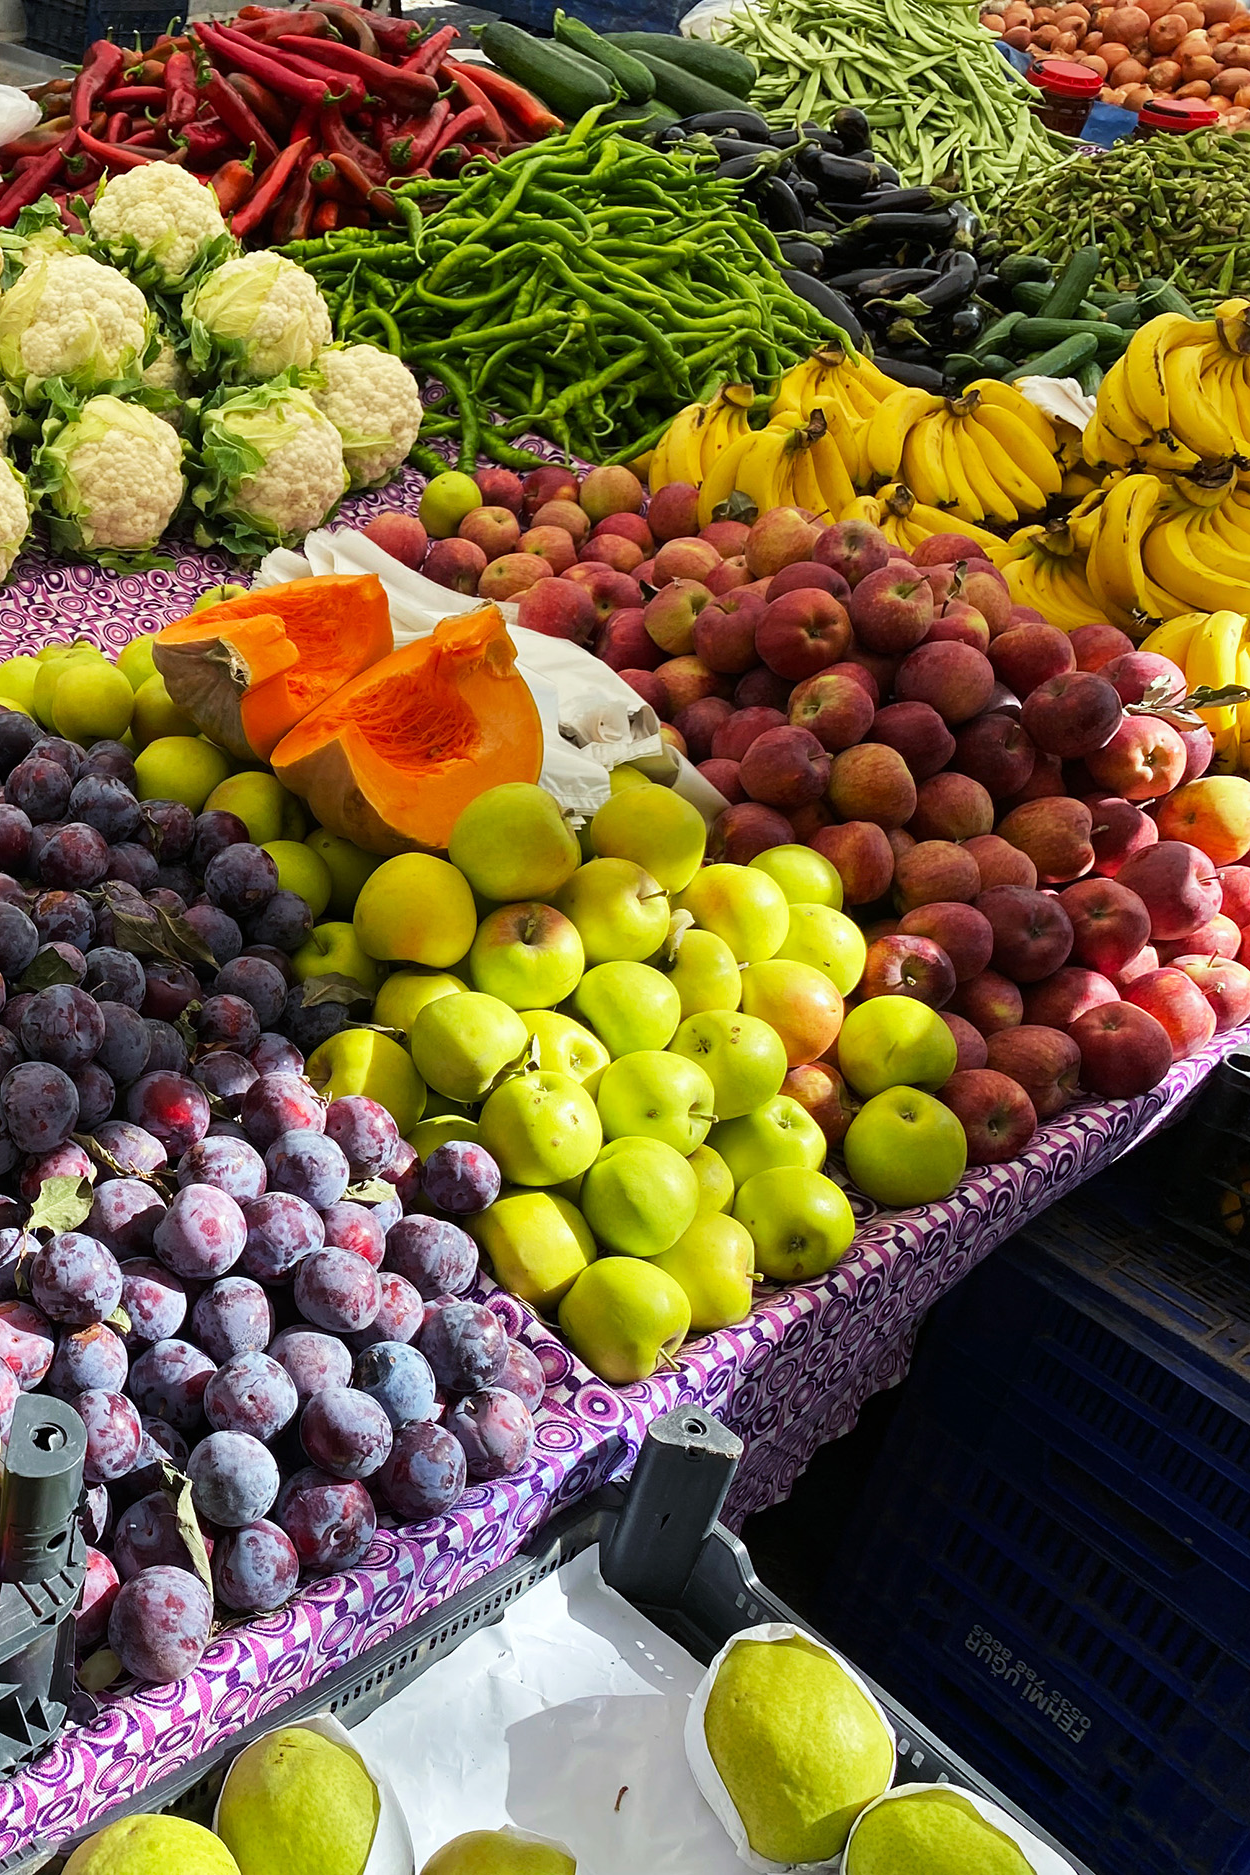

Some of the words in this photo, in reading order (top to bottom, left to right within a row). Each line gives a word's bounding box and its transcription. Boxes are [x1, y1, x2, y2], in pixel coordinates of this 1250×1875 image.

[964, 1631, 1021, 1688] UĞUR
[971, 1623, 1014, 1661] 8665
[1014, 1659, 1047, 1692] 788
[1019, 1682, 1086, 1744] FEHMİ
[1049, 1689, 1091, 1730] 0535
